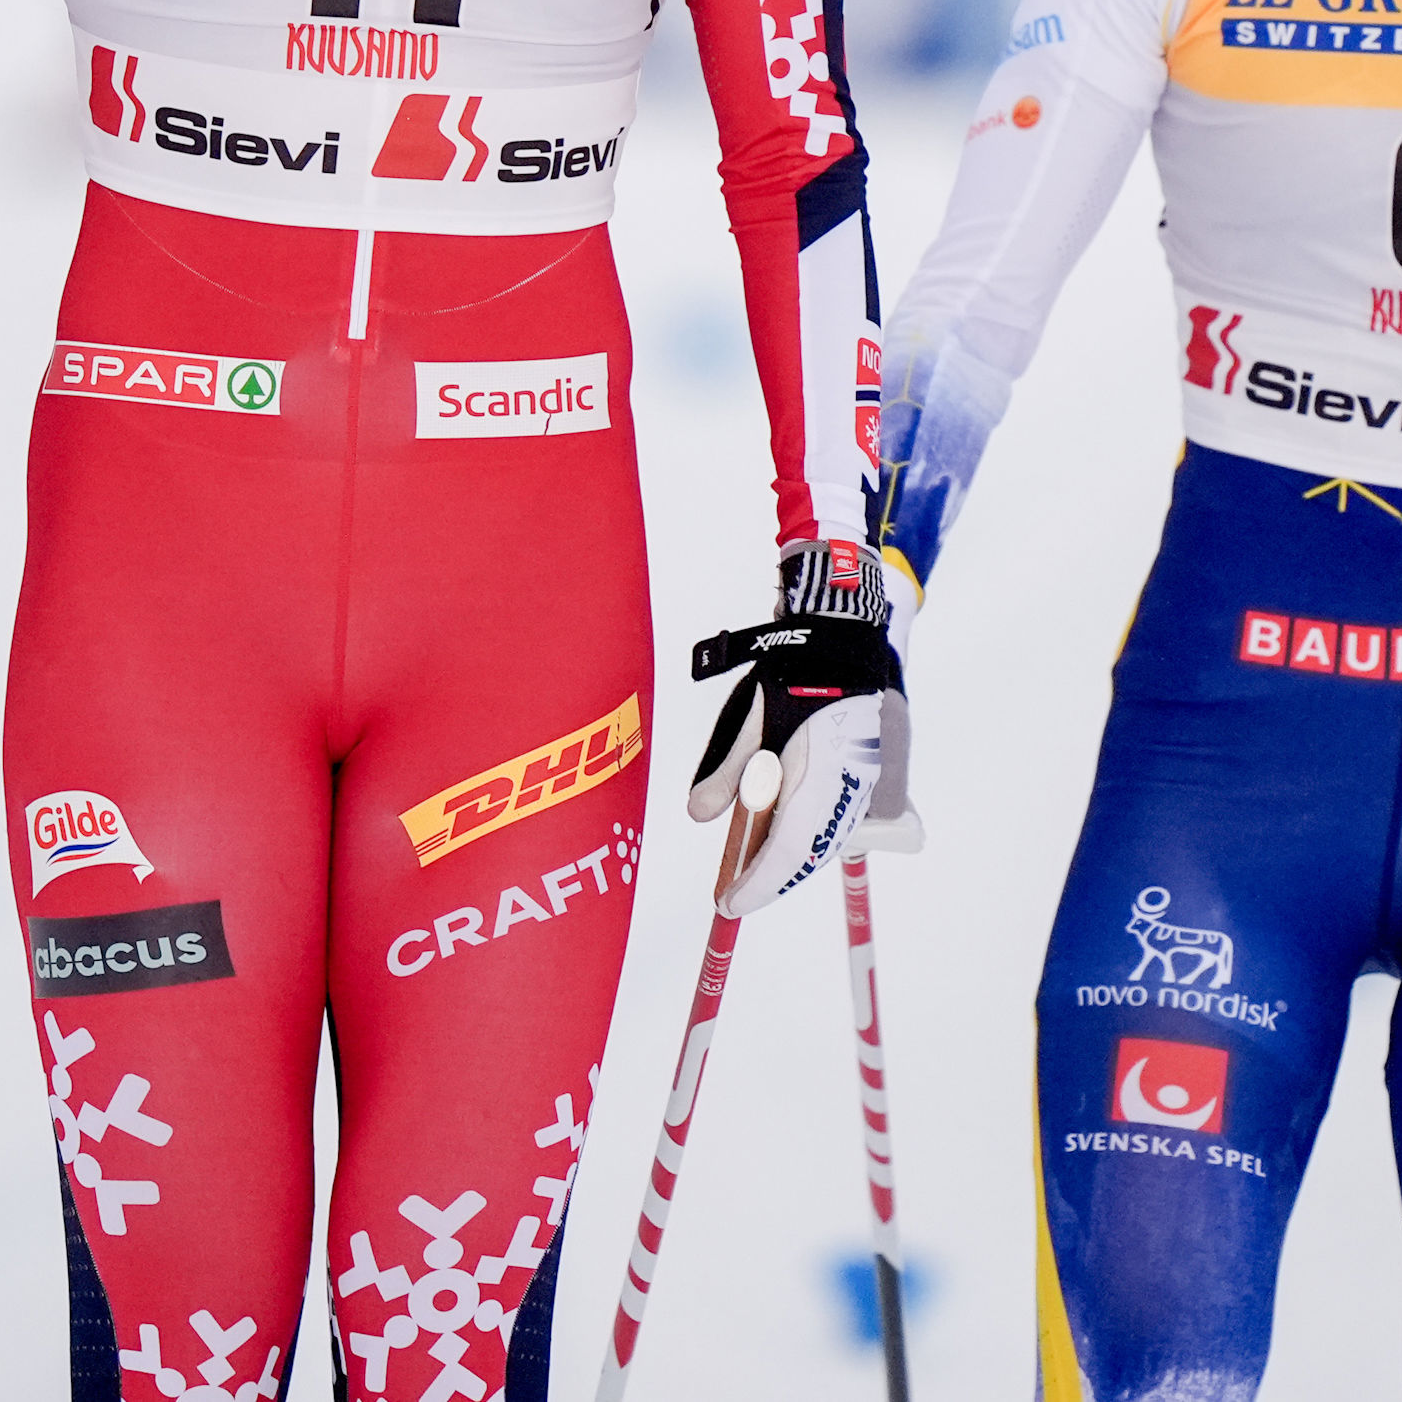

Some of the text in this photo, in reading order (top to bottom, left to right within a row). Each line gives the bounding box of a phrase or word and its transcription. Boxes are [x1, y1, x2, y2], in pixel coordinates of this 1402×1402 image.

[286, 22, 439, 81] KUUSAMO
[154, 106, 341, 174] Sievi
[497, 126, 625, 183] Sievi
[62, 351, 213, 398] SPAR
[438, 378, 595, 419] Scandic
[443, 724, 622, 841] DHL
[33, 799, 118, 849] Gilde
[386, 843, 611, 978] CRAFT
[34, 929, 208, 980] abacus
[1076, 985, 1279, 1031] novo nordisk
[1064, 1131, 1266, 1178] SVENSKA SPEL
